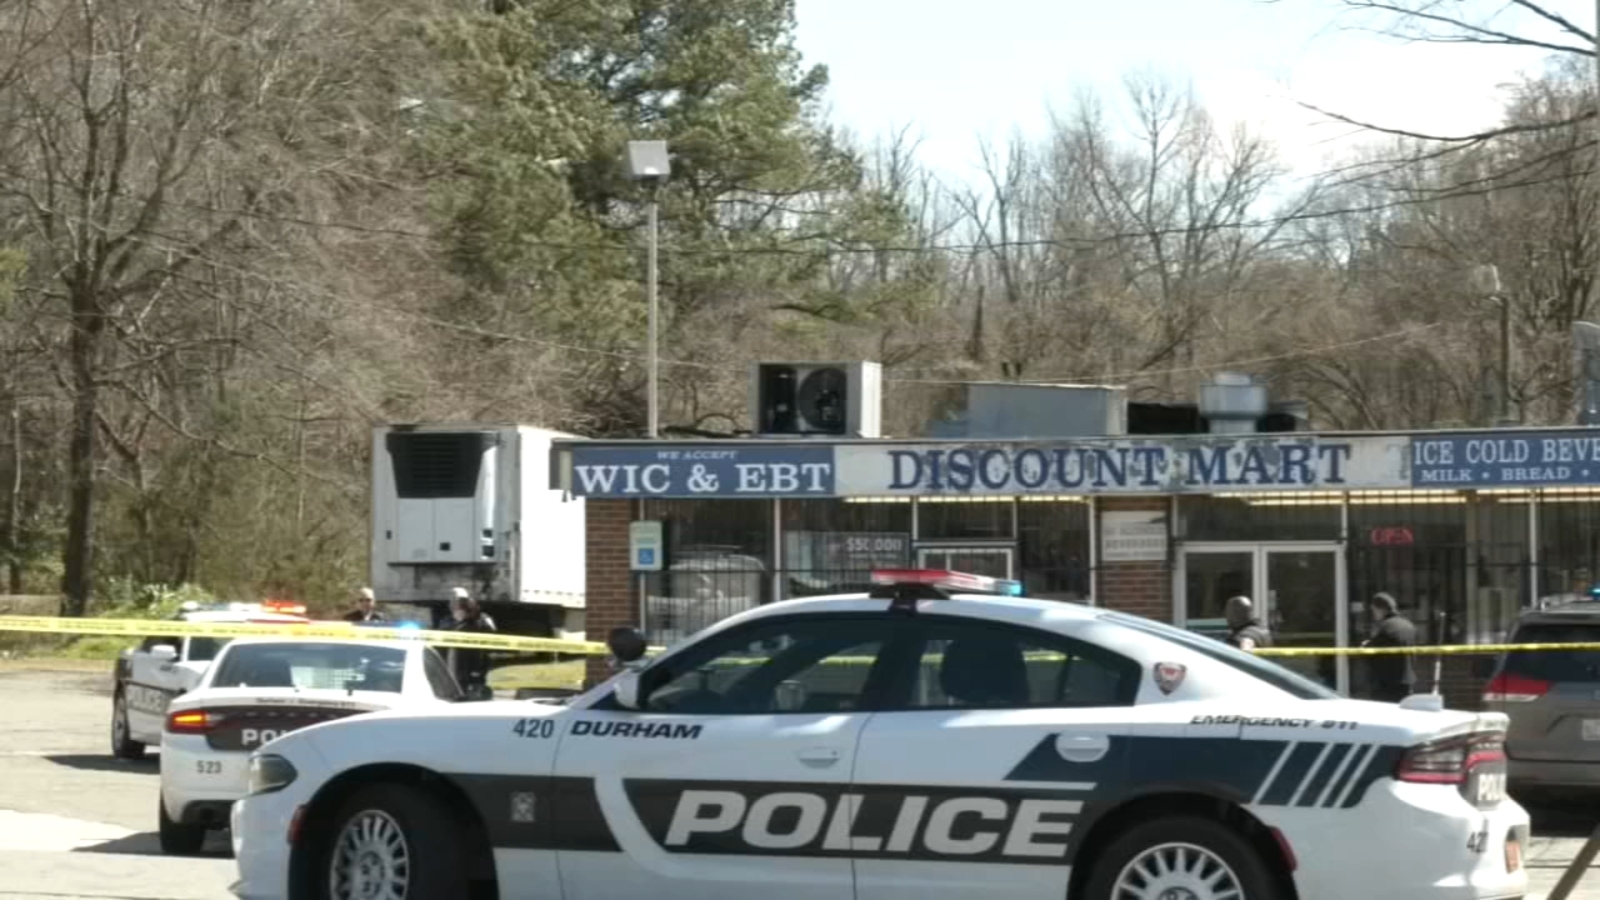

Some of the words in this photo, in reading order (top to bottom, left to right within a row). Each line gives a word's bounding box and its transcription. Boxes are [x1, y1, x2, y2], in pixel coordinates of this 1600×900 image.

[1414, 441, 1454, 465] ICE
[1466, 439, 1529, 464] COLD
[575, 464, 670, 493] WIC
[687, 464, 719, 492] &
[735, 463, 831, 492] EBT
[888, 449, 1165, 491] DISCOUNT
[1187, 444, 1351, 486] MART
[1420, 469, 1473, 482] MILK
[1502, 466, 1571, 481] BREAD
[513, 718, 554, 739] 420
[570, 720, 703, 740] DURHAM
[196, 759, 222, 774] 523
[665, 790, 1083, 857] POLICE
